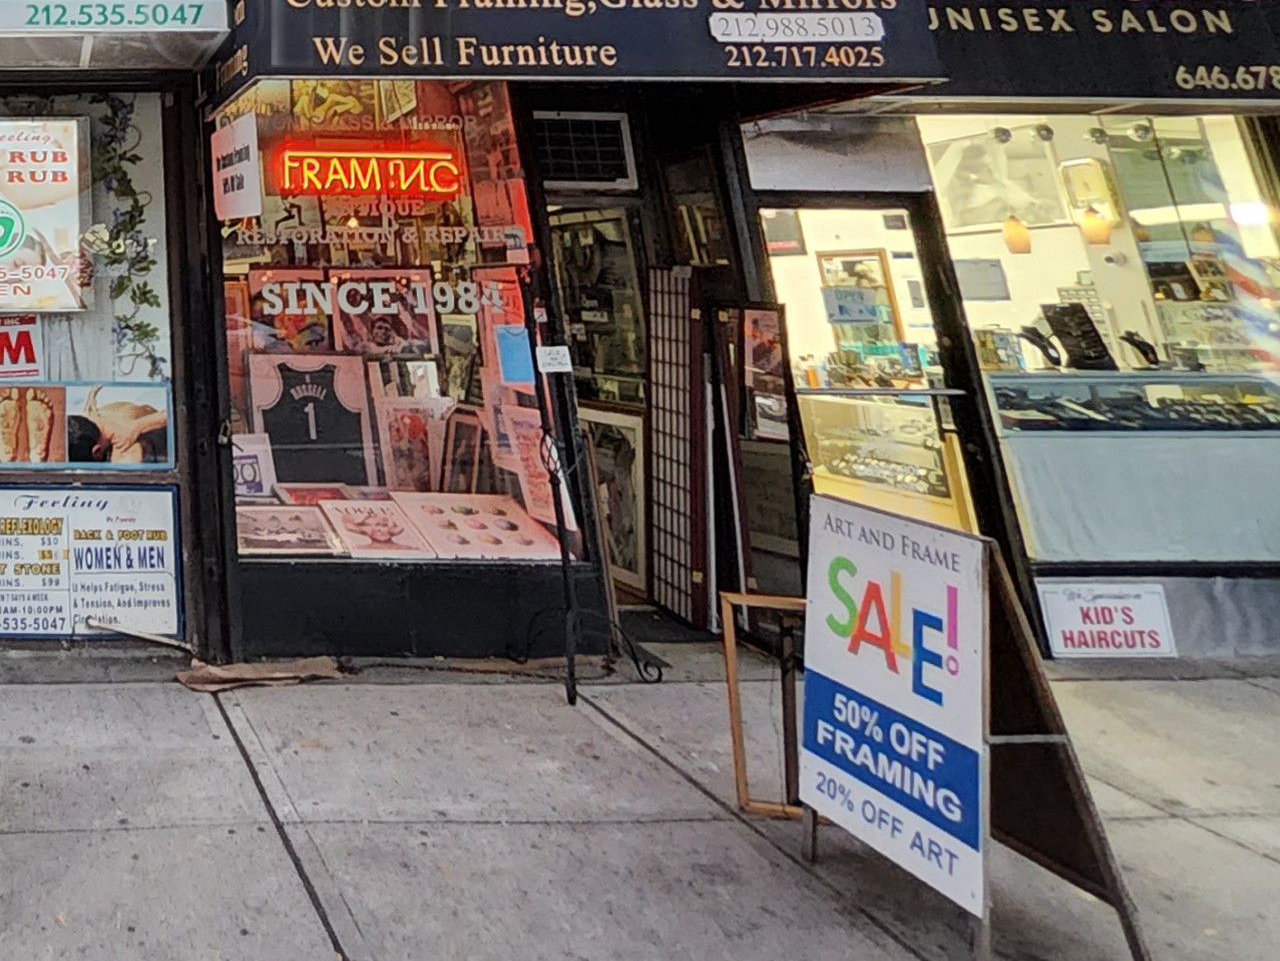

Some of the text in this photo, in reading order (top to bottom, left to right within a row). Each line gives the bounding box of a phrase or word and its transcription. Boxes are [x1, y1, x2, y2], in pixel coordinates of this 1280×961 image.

[25, 2, 204, 28] 212.535.5047
[1092, 9, 1234, 35] SALON
[716, 16, 876, 38] 212.988.5013
[312, 36, 618, 68] We Sell Furniture
[726, 45, 886, 68] 212.717.4025
[8, 150, 69, 164] RUB
[7, 170, 69, 183] RUB
[236, 226, 398, 245] RESTORATION
[402, 227, 418, 244] &
[262, 280, 505, 315] SINCE 1984
[303, 401, 318, 440] 1
[14, 495, 109, 510] Feeling
[0, 517, 65, 535] REFLEXOLOGY
[73, 529, 102, 541] BACK
[117, 529, 145, 541] FOOT
[145, 529, 168, 541] RUB
[823, 512, 961, 574] ART AND FRAME
[14, 563, 61, 575] STONE
[74, 547, 121, 570] WOMEN
[126, 546, 134, 569] &
[138, 546, 166, 569] MEN
[80, 582, 103, 594] Helps
[139, 581, 165, 592] Stress
[1079, 606, 1135, 626] KID'S
[824, 554, 961, 707] SALE!
[1061, 629, 1161, 649] HAIRCUTS
[832, 692, 946, 772] 50% OFF
[816, 719, 965, 824] FRAMING
[816, 771, 960, 877] 20% OFF ART
